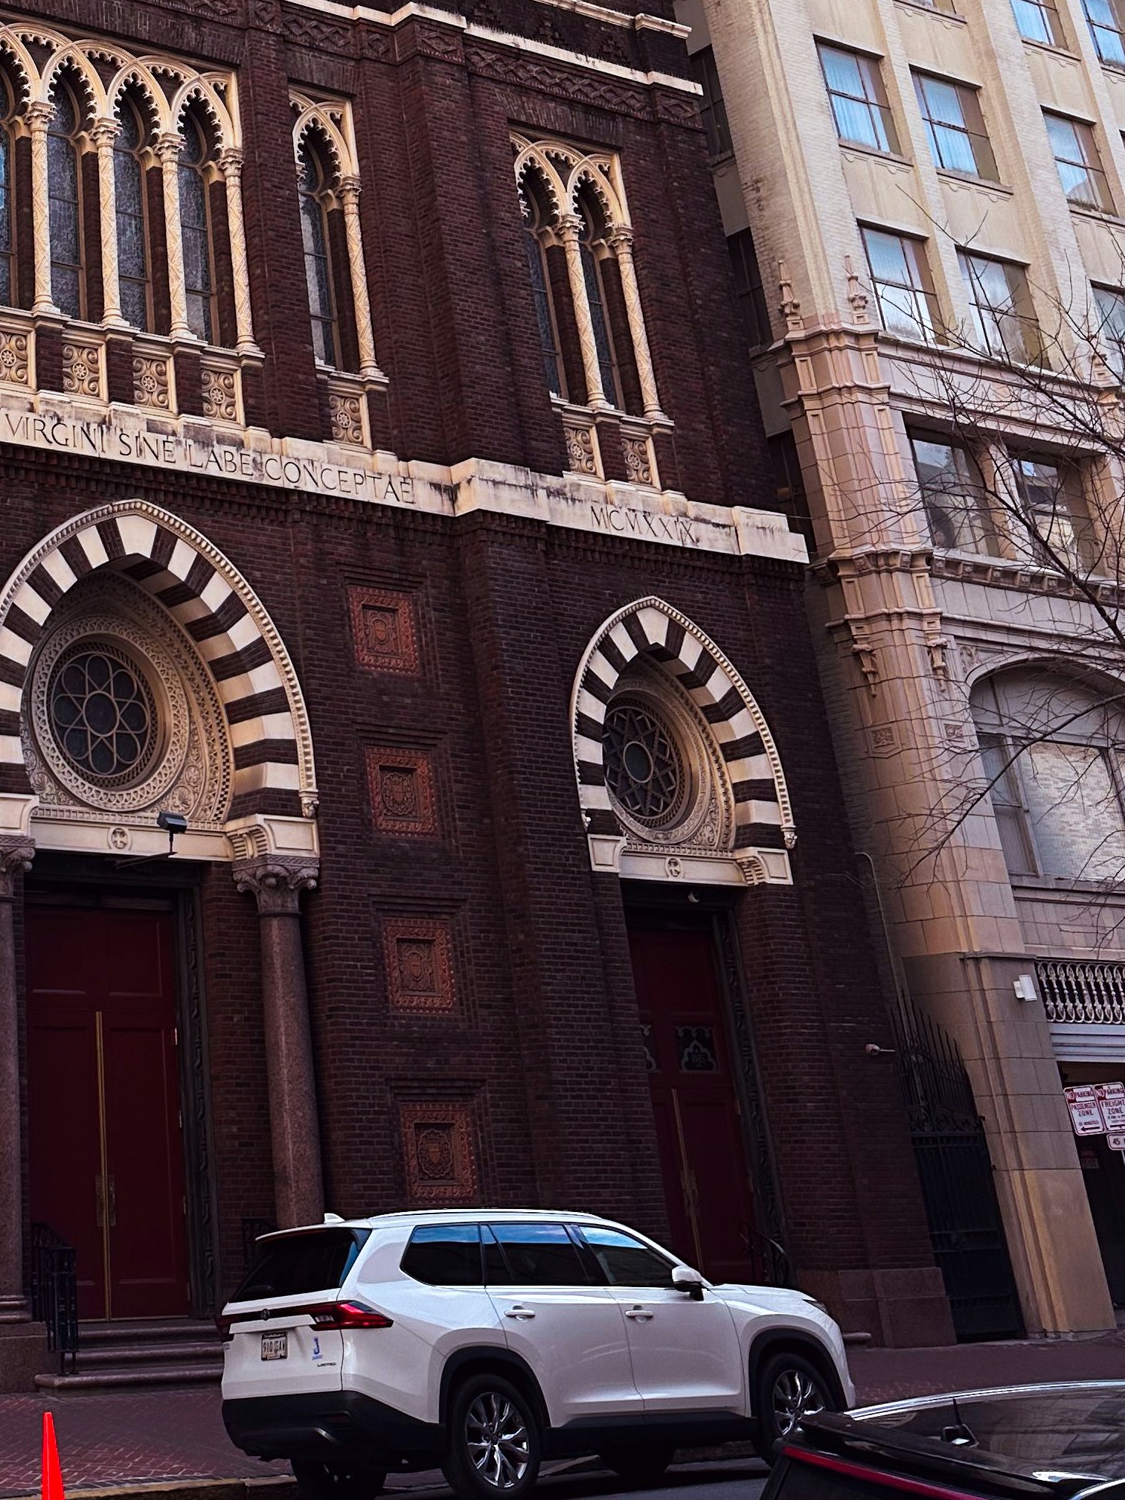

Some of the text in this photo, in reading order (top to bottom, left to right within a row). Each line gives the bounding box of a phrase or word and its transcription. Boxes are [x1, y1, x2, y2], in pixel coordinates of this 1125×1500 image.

[5, 413, 106, 453] VIRGINI
[119, 432, 176, 464] SINE
[188, 444, 255, 476] LABE
[263, 458, 416, 505] CONCEPTAE
[589, 505, 698, 545] MCMXXIX
[1108, 1107, 1124, 1115] ZONE
